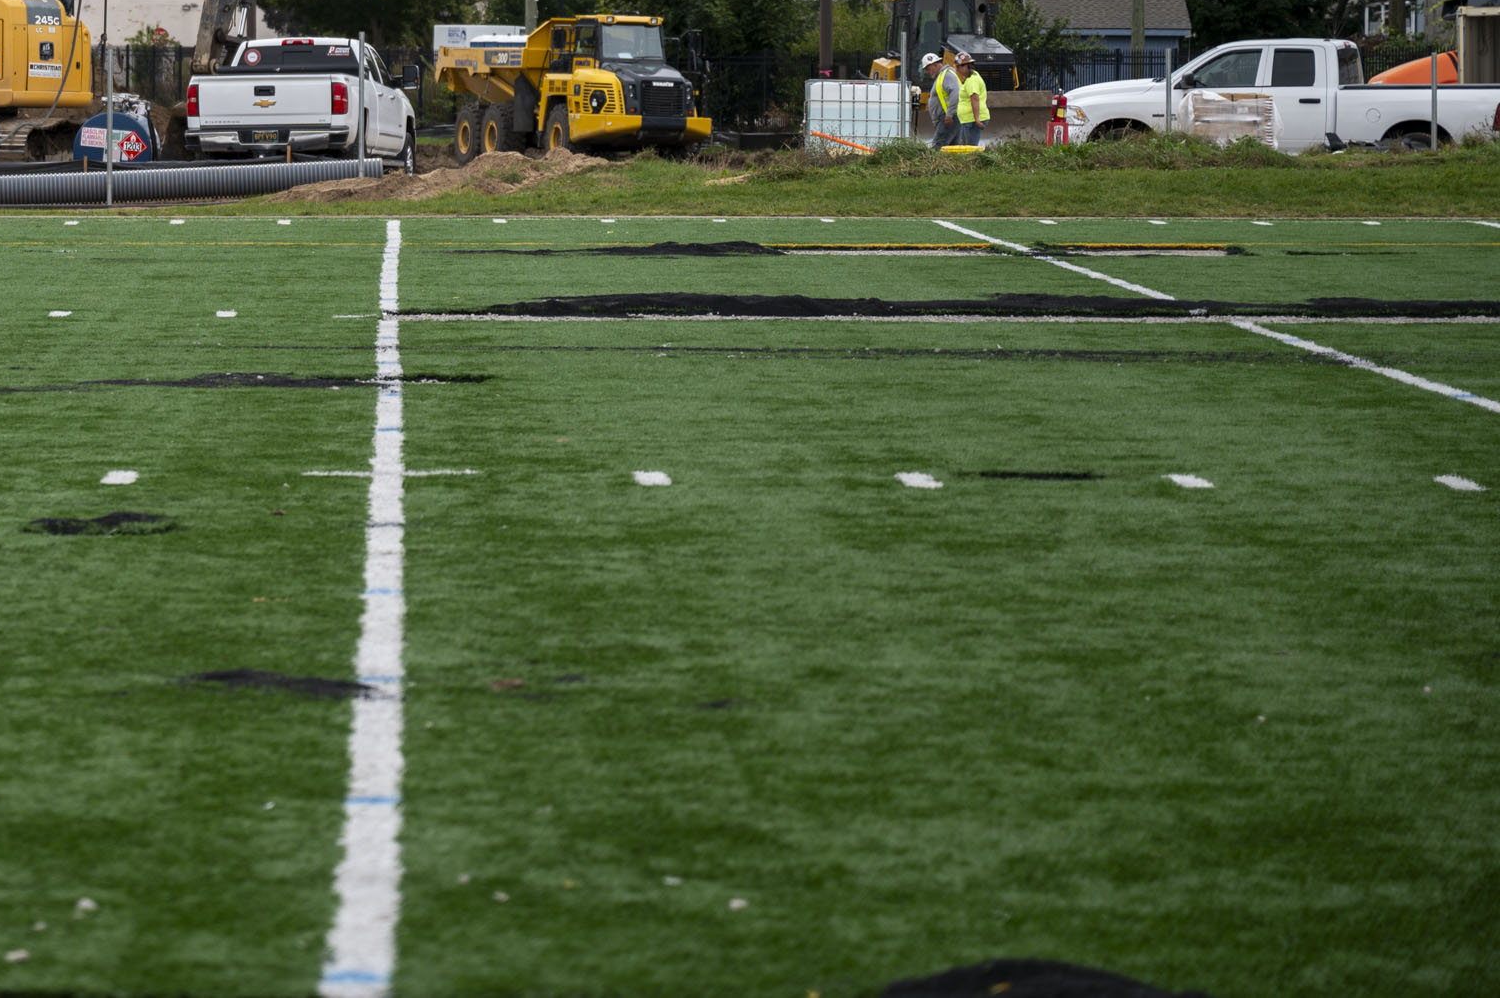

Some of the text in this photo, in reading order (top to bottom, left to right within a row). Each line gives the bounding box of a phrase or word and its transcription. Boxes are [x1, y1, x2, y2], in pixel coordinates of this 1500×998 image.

[34, 14, 60, 26] 245G
[30, 64, 62, 72] CHRISTMAN
[124, 142, 141, 151] 1203
